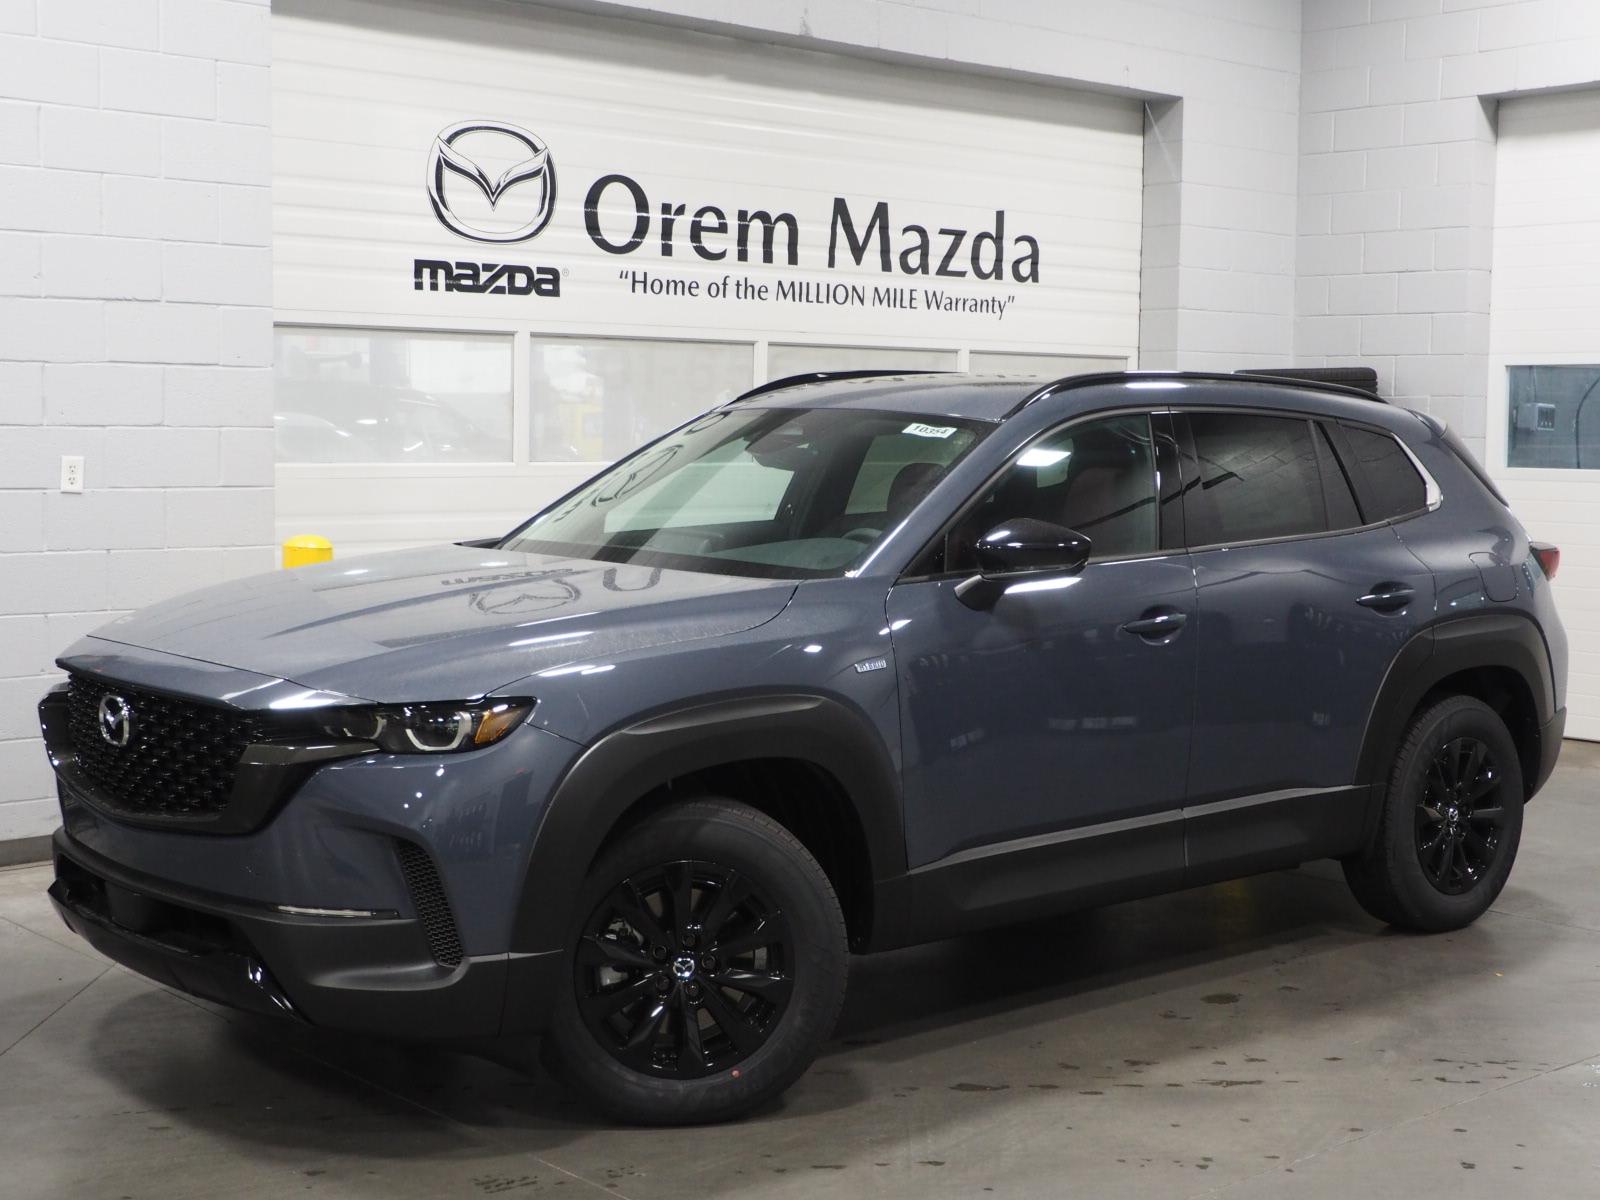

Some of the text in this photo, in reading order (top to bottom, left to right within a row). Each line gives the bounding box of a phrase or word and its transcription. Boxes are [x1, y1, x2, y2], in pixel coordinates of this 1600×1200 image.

[584, 174, 1040, 284] Orem Mazda
[707, 275, 730, 299] of
[735, 277, 769, 301] the
[775, 280, 866, 307] MILLION
[872, 286, 918, 310] MILE
